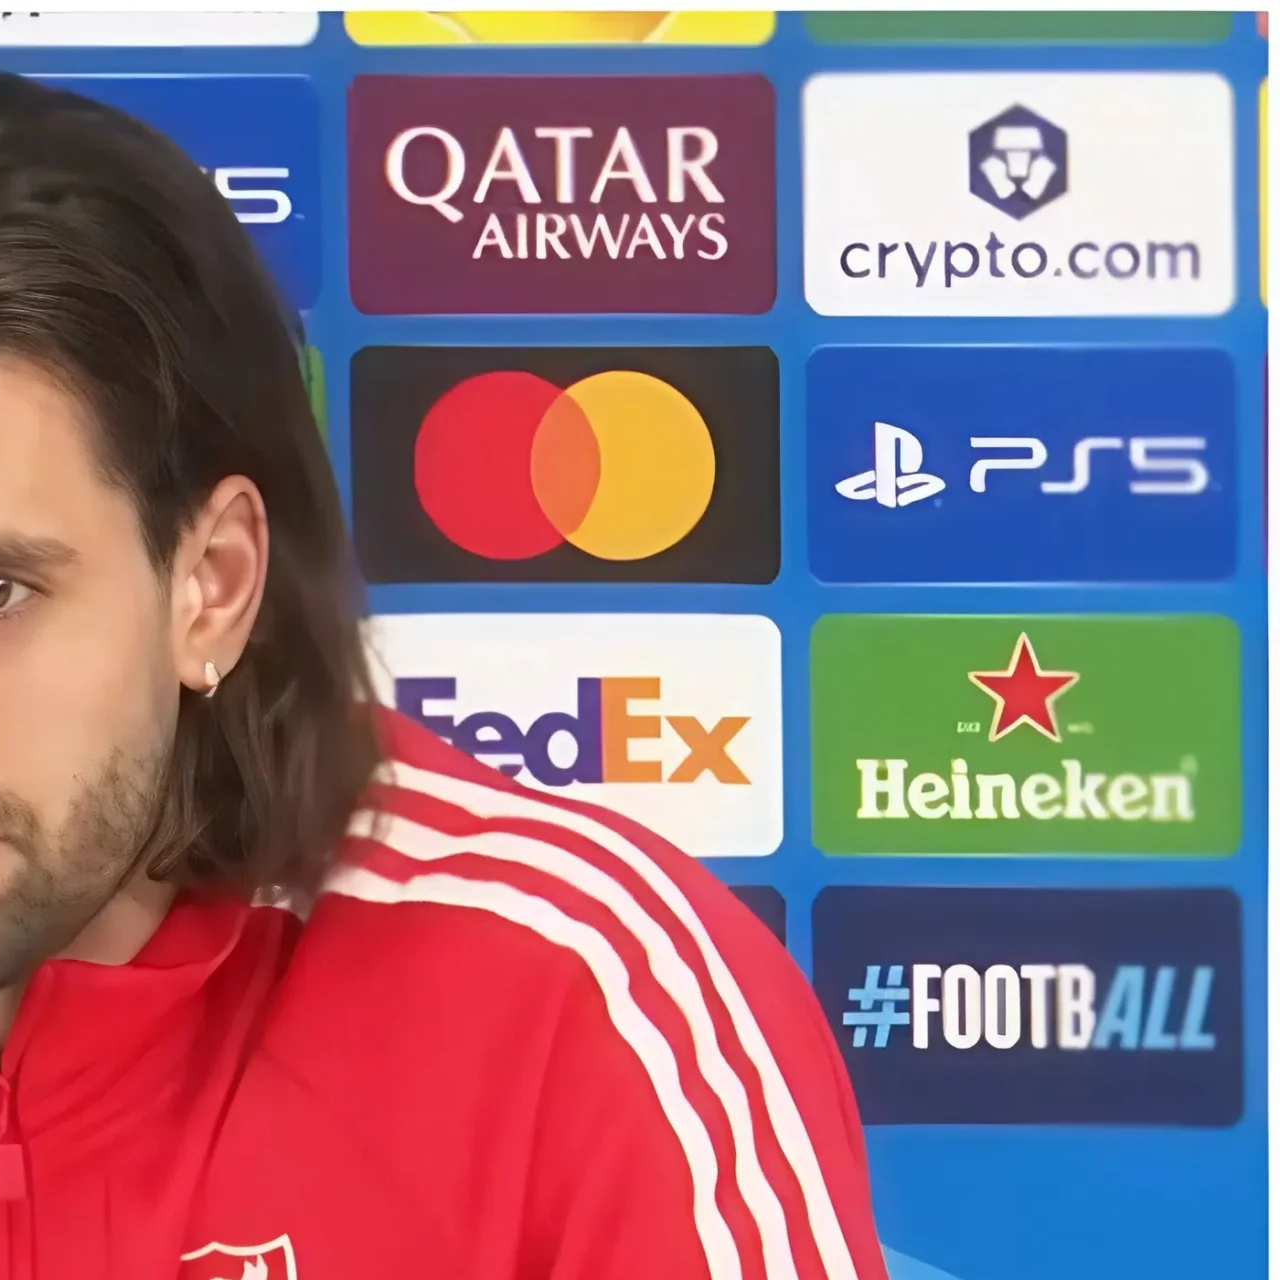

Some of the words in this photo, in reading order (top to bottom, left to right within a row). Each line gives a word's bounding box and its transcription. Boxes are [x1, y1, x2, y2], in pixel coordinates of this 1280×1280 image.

[385, 126, 725, 224] QATAR
[472, 212, 729, 263] AIRWAYS
[839, 231, 1202, 288] crypto.com
[968, 435, 1210, 495] PS5
[856, 758, 1195, 821] Heineken
[842, 963, 1216, 1050] #FOOTBALL
